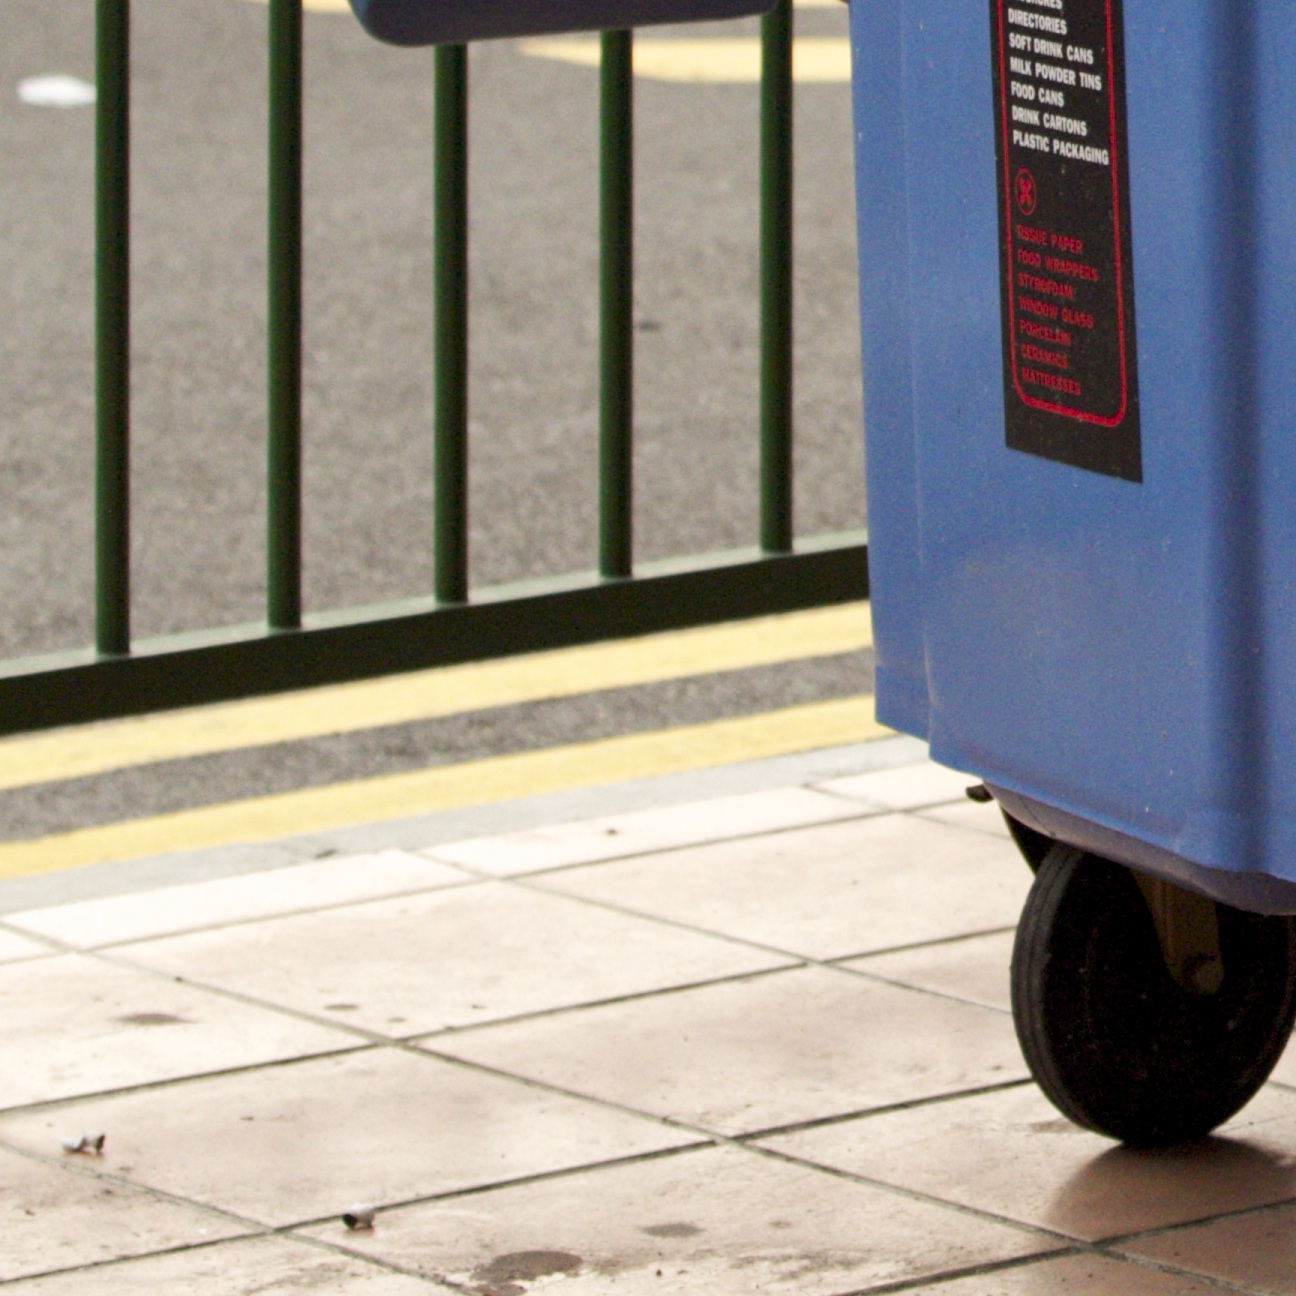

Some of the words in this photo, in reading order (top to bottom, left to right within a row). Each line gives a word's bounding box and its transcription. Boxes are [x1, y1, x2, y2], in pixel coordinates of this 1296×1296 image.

[1008, 8, 1067, 35] DIRECTORIES
[1009, 33, 1031, 52] SOFT
[1034, 39, 1063, 58] DRINK
[1067, 45, 1094, 64] CANS
[1010, 57, 1032, 76] MILK
[1035, 63, 1076, 85] POWDER
[1079, 72, 1102, 91] TINS
[1011, 81, 1035, 100] FOOD
[1038, 88, 1064, 107] CANS
[1012, 106, 1040, 126] DRINK
[1043, 113, 1087, 136] CARTONS
[1013, 130, 1049, 152] PLASTIC
[1053, 140, 1109, 165] PACKAGING
[1051, 234, 1082, 254] PAPER
[1062, 307, 1093, 328] GLASS
